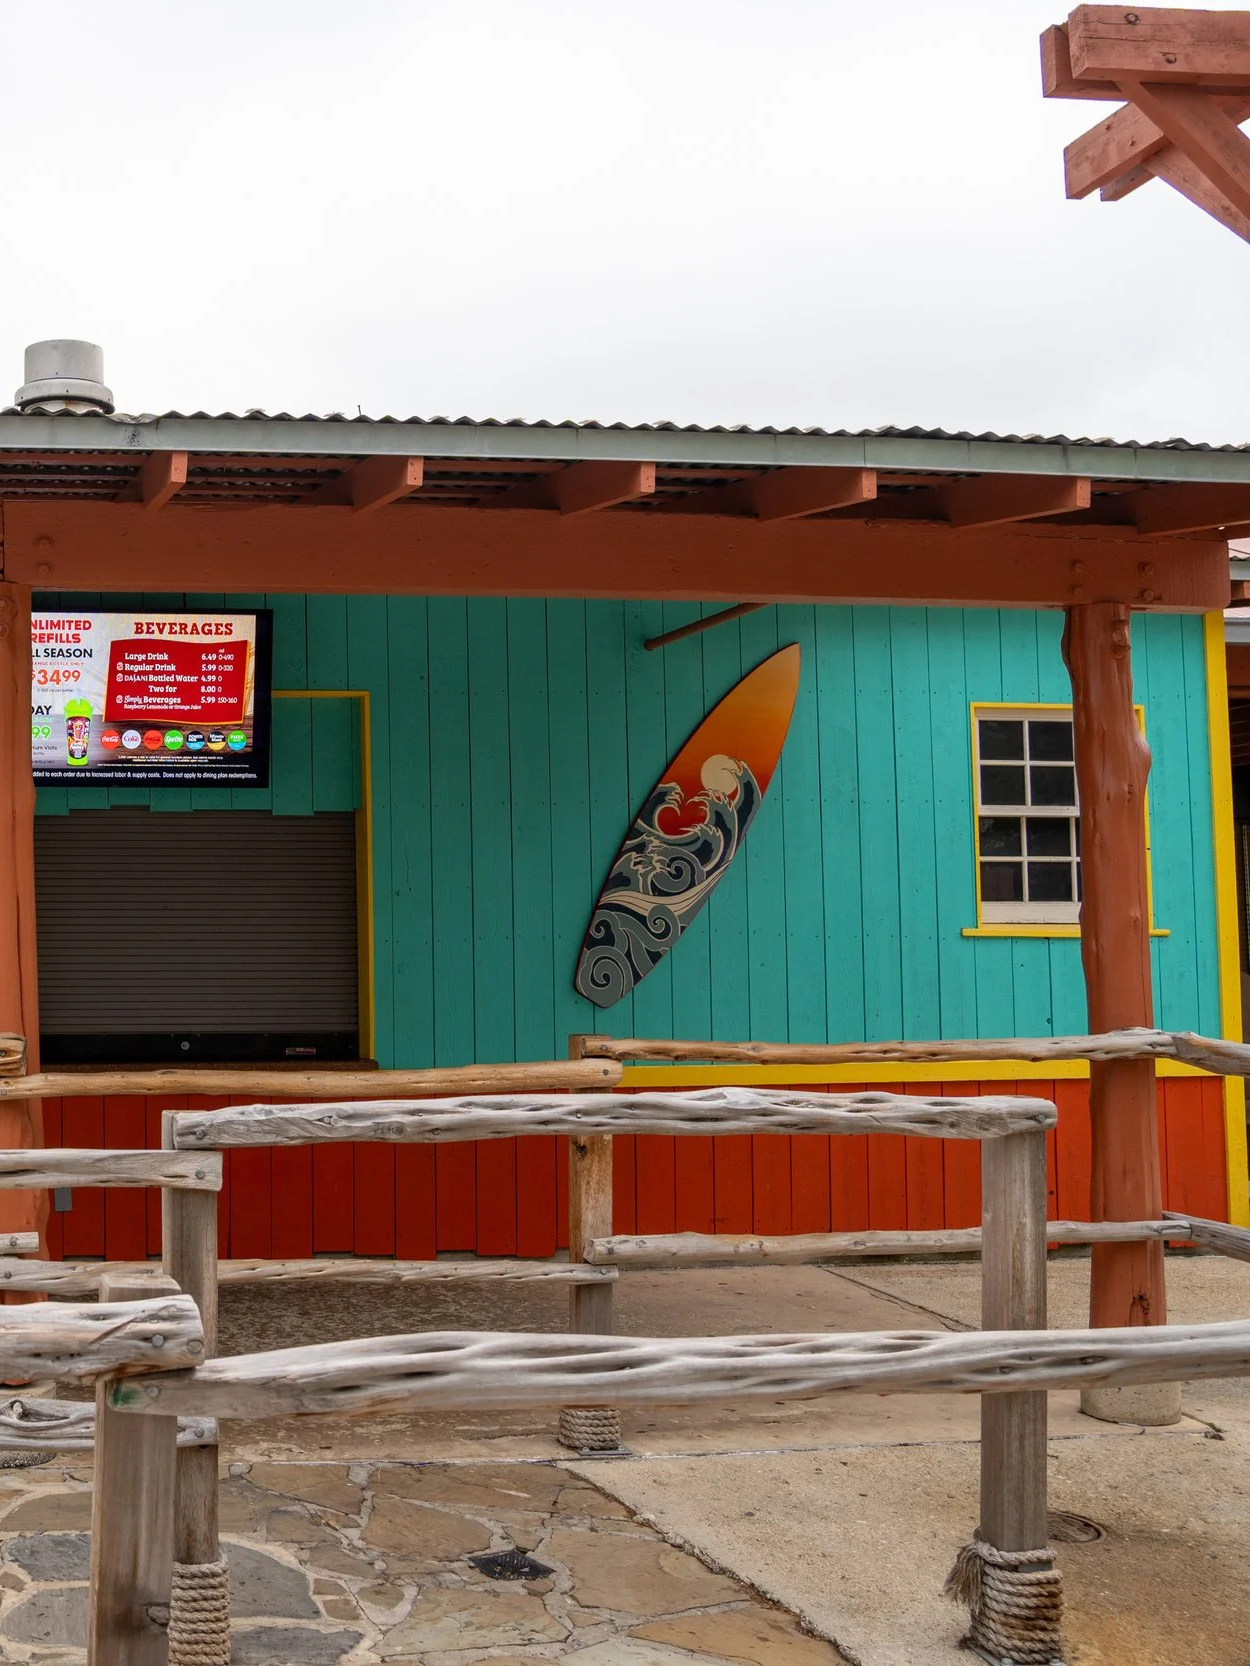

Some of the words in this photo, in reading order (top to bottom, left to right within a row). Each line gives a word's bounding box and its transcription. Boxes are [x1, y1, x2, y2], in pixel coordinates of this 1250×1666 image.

[32, 620, 92, 630] NLIMITED
[134, 622, 233, 635] BEVERAGES
[44, 648, 92, 658] SEASON
[125, 653, 146, 661] Large
[125, 664, 154, 672] Regular
[143, 696, 181, 704] Beverages
